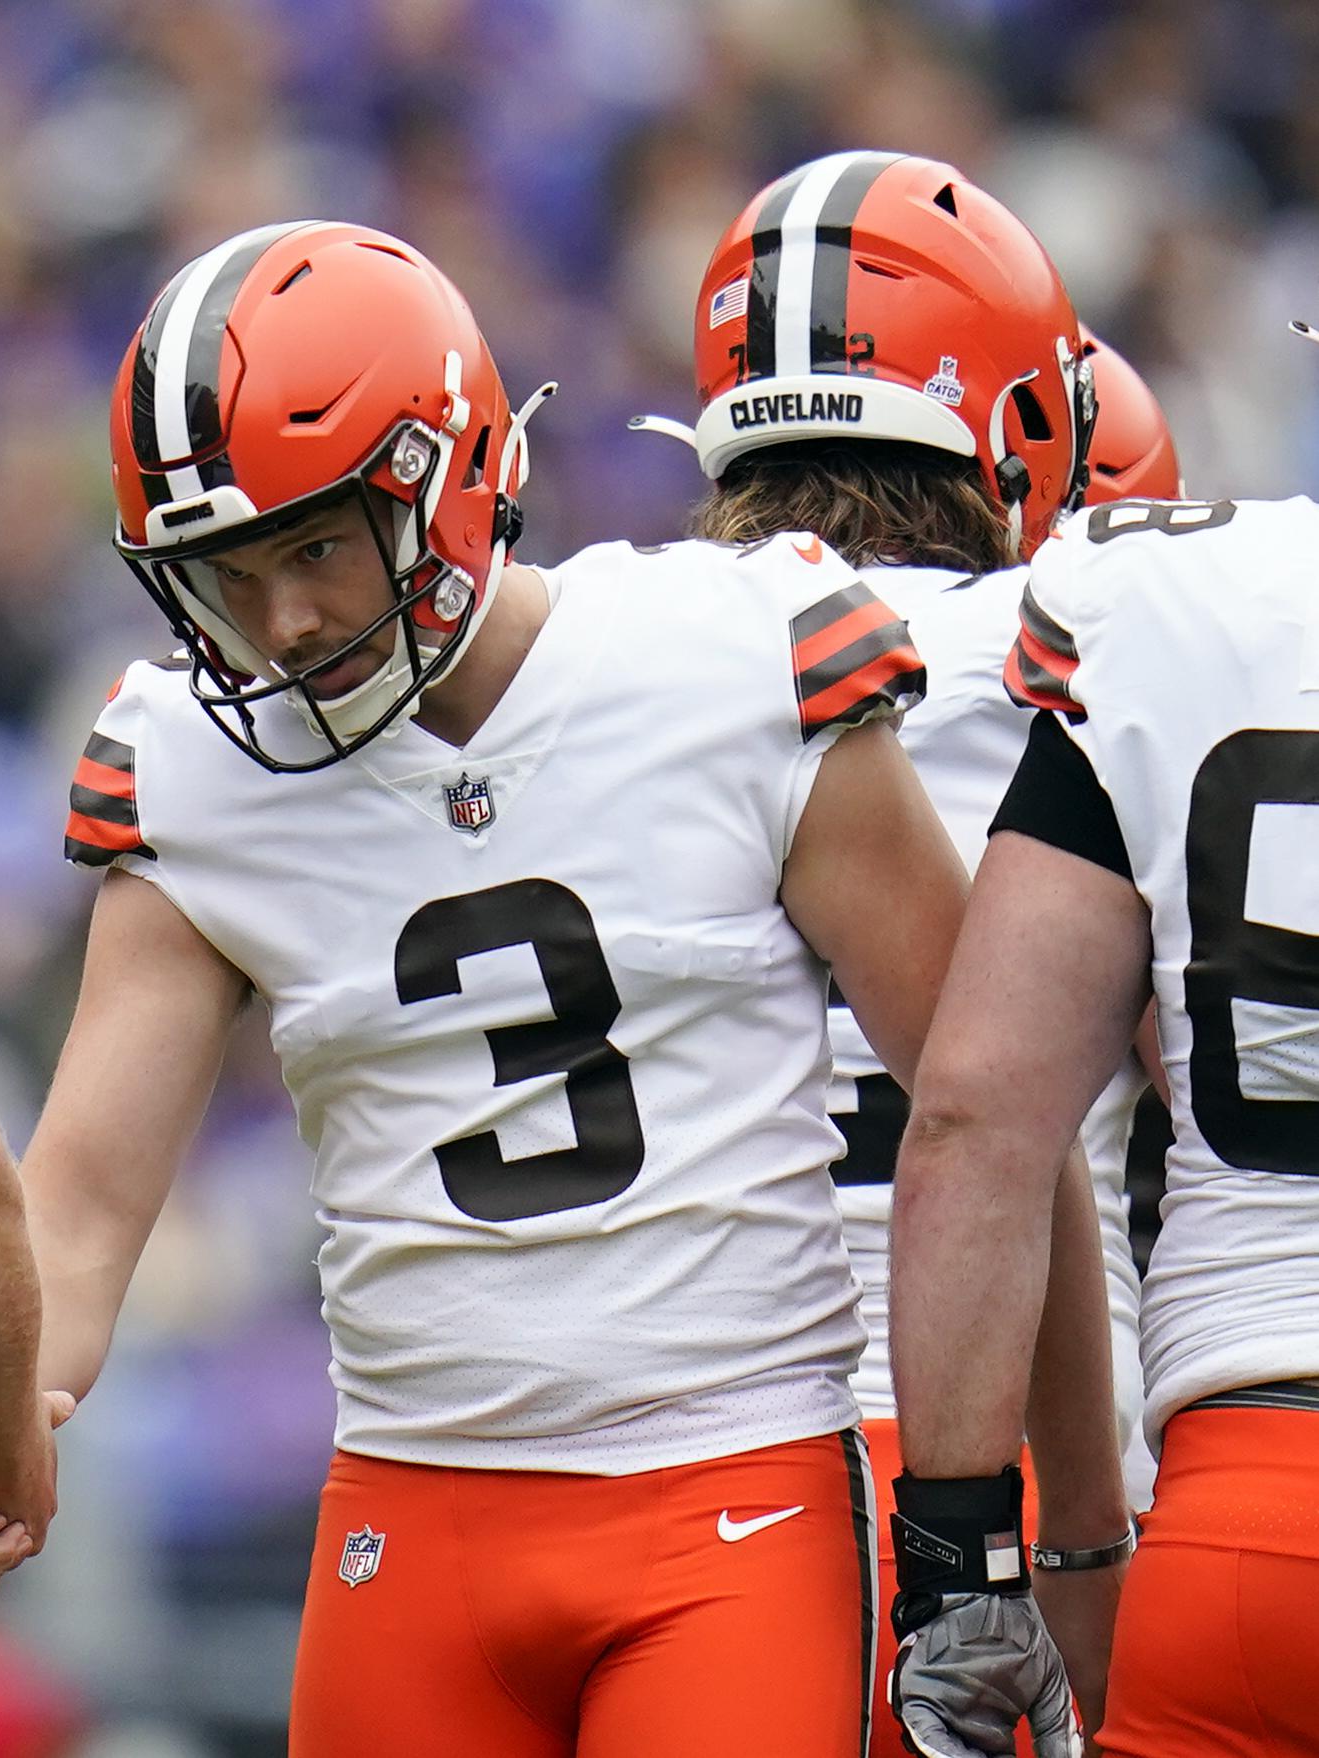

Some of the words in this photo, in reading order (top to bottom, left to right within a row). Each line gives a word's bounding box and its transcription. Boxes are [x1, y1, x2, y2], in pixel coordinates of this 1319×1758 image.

[848, 333, 875, 378] 2
[926, 382, 962, 400] CATCH
[730, 392, 863, 429] CLEVELAND
[454, 800, 488, 824] NFL
[394, 877, 645, 1222] 3
[345, 1554, 370, 1576] NFL
